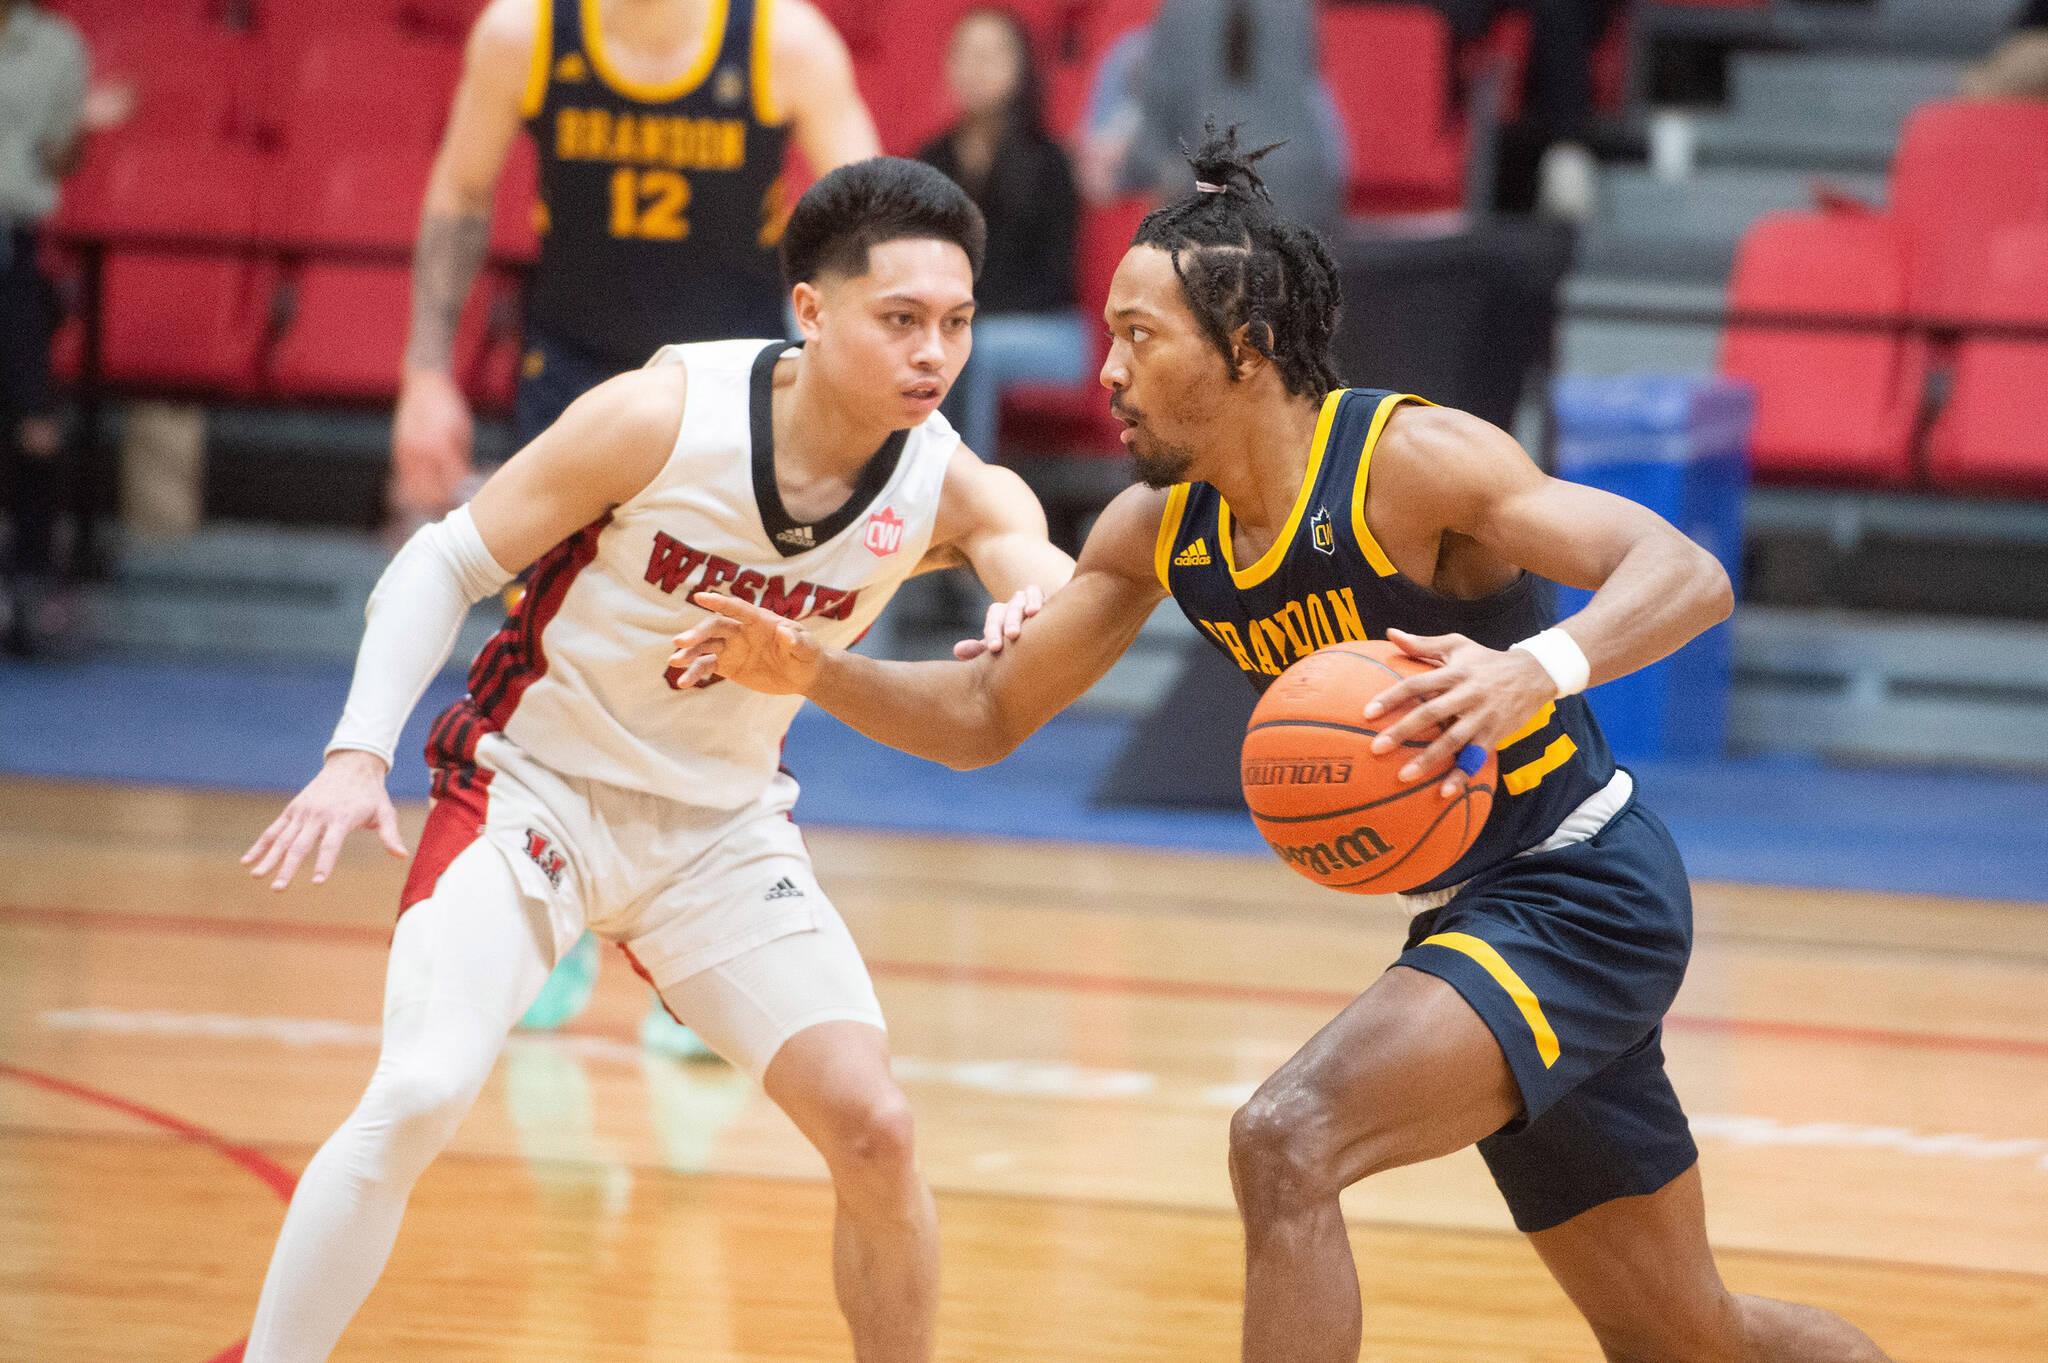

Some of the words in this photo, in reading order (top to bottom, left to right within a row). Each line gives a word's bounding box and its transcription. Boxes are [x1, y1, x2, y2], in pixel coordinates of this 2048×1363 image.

[609, 168, 691, 240] 12
[1174, 555, 1212, 566] adidas
[1243, 763, 1353, 786] EVOLUTIO
